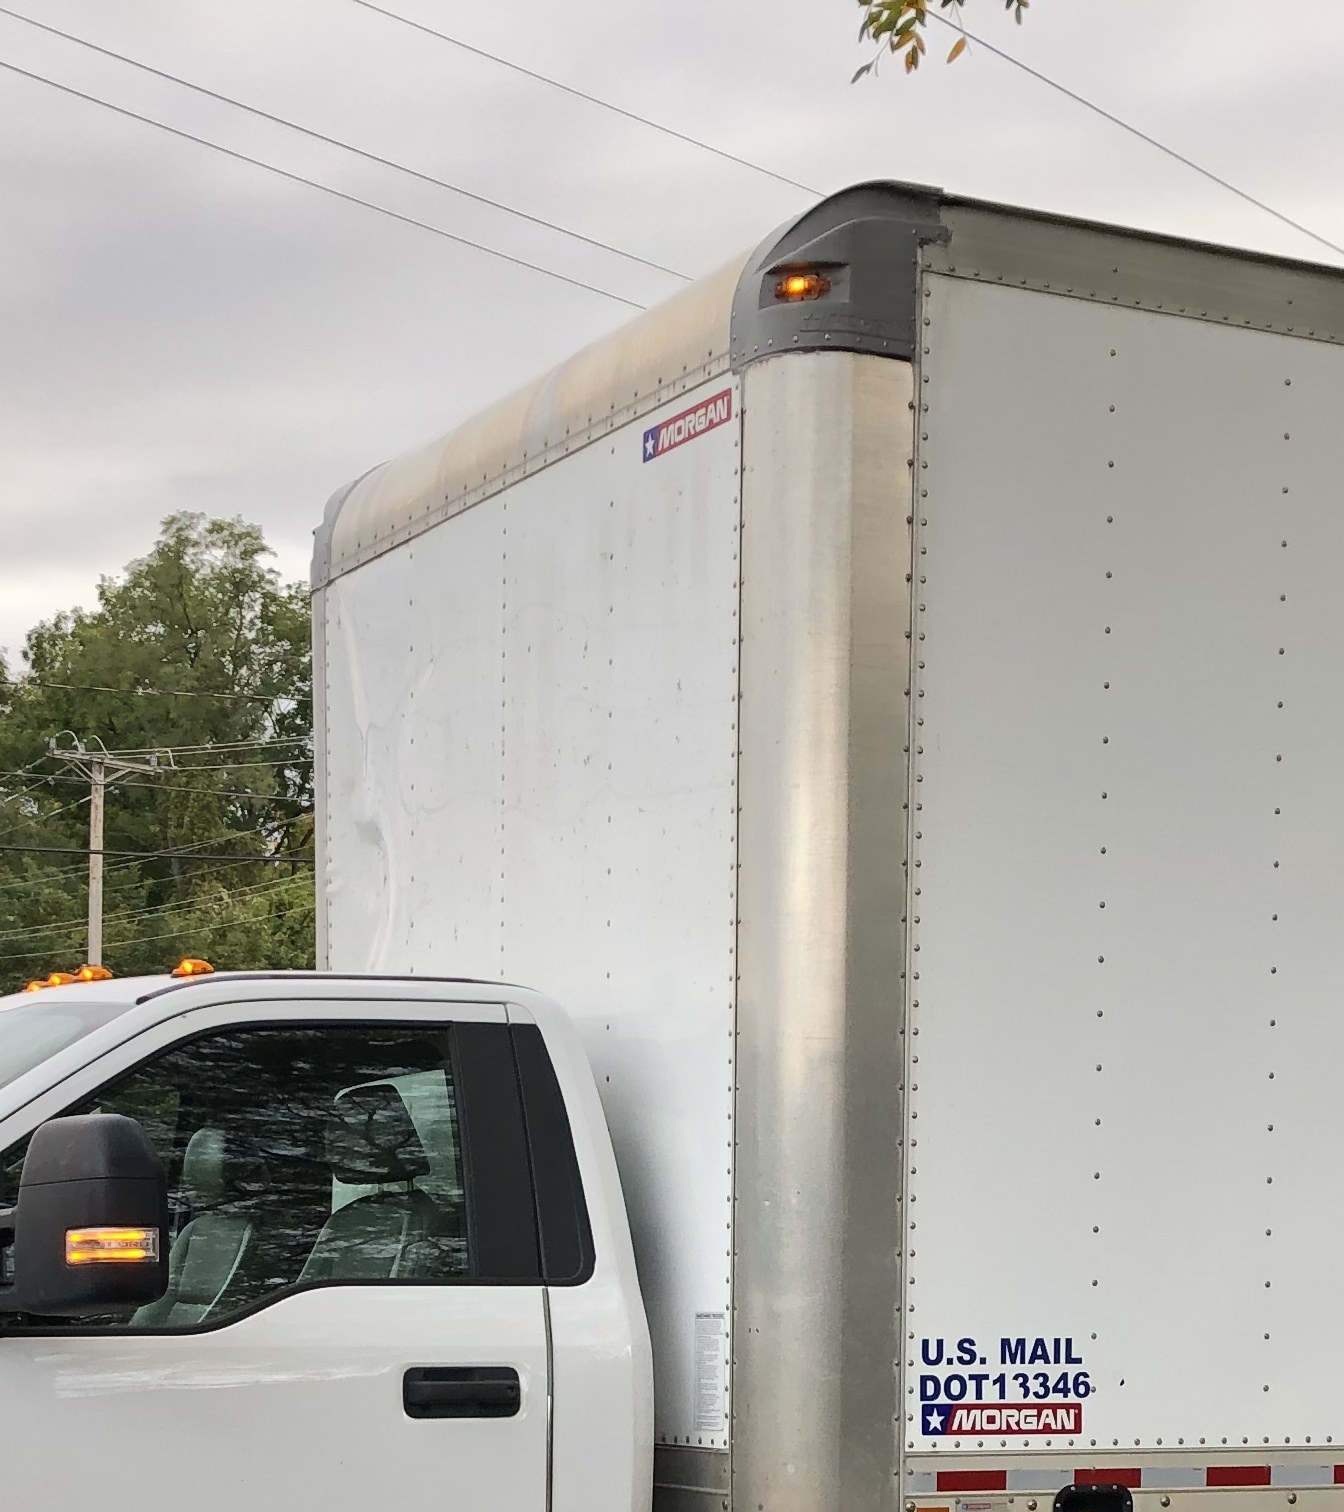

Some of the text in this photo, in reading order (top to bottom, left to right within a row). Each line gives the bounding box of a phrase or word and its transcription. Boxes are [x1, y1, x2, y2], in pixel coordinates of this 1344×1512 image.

[657, 396, 729, 452] MORGAN
[921, 1337, 1083, 1366] U.S. MAIL
[951, 1408, 1076, 1431] MORGAN
